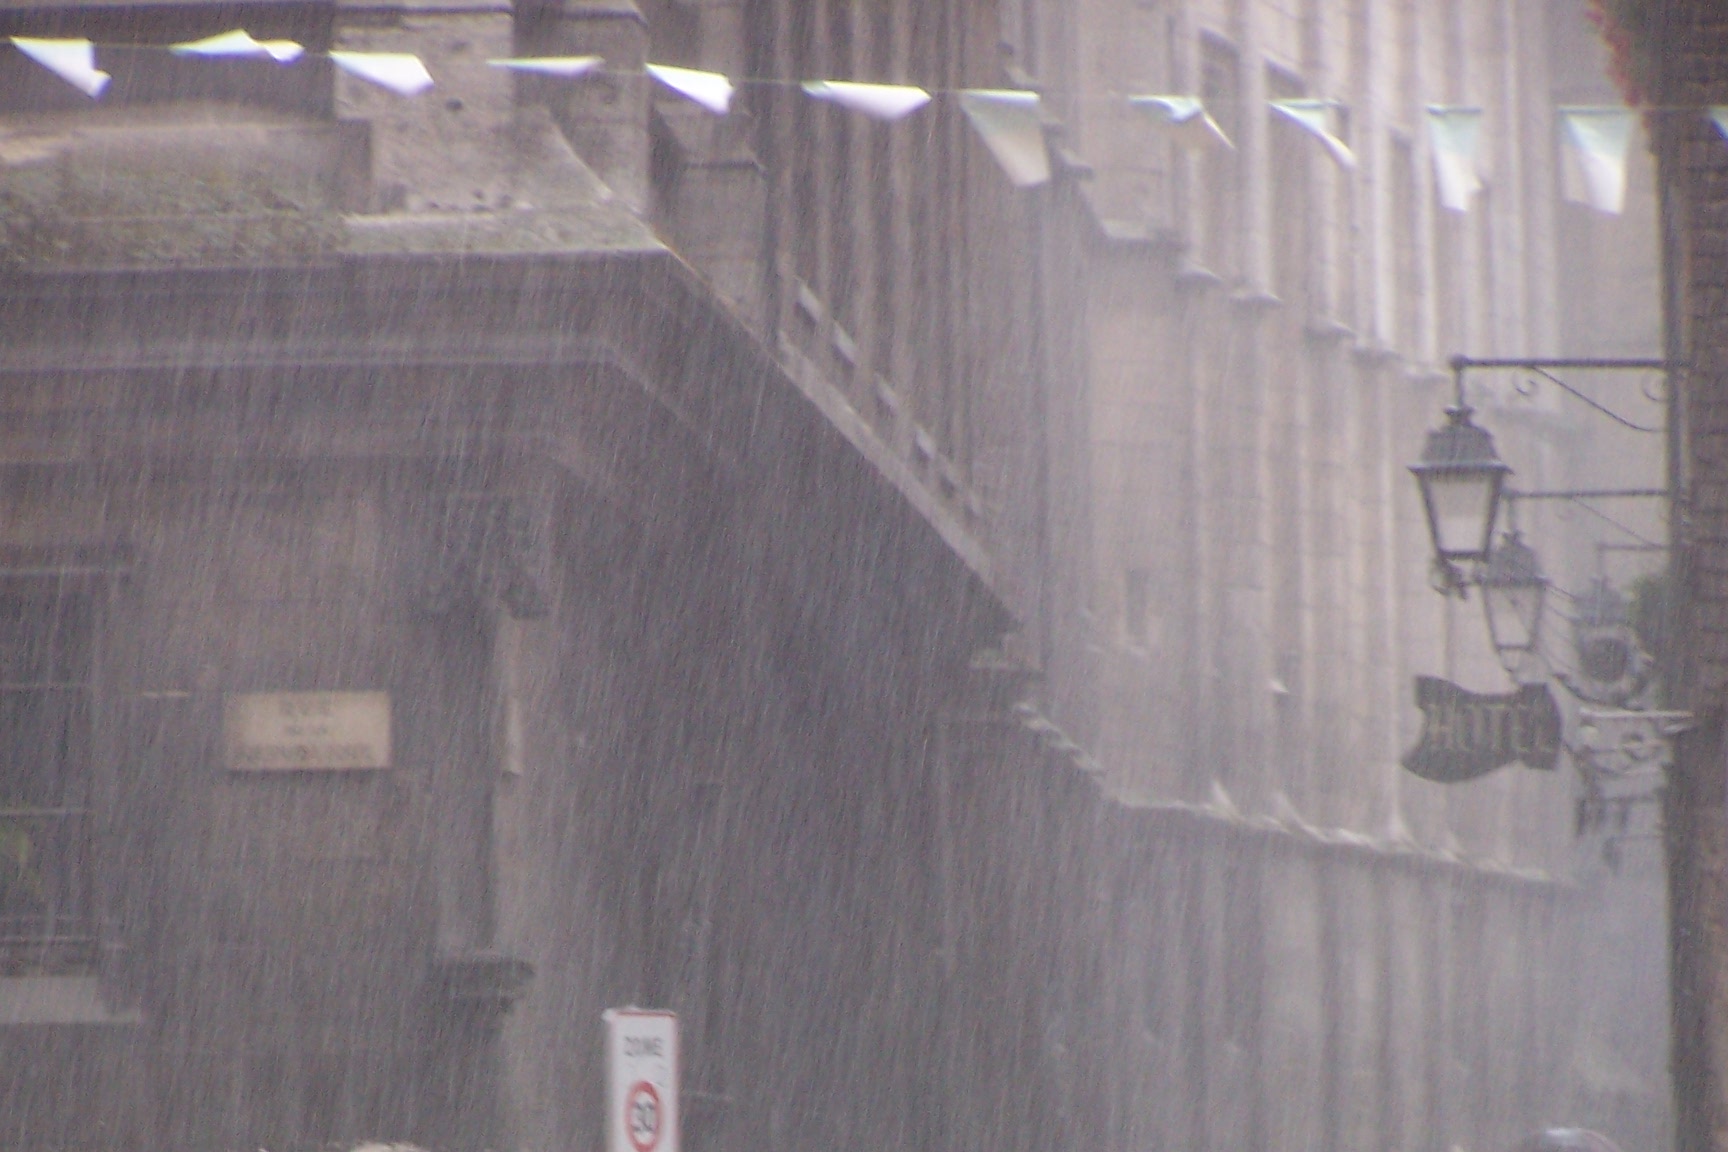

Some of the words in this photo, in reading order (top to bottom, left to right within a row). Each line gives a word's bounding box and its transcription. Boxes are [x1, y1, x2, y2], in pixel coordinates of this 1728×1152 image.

[1427, 701, 1553, 753] HOTEL
[624, 1036, 665, 1057] ZONE
[632, 1101, 658, 1132] 30
